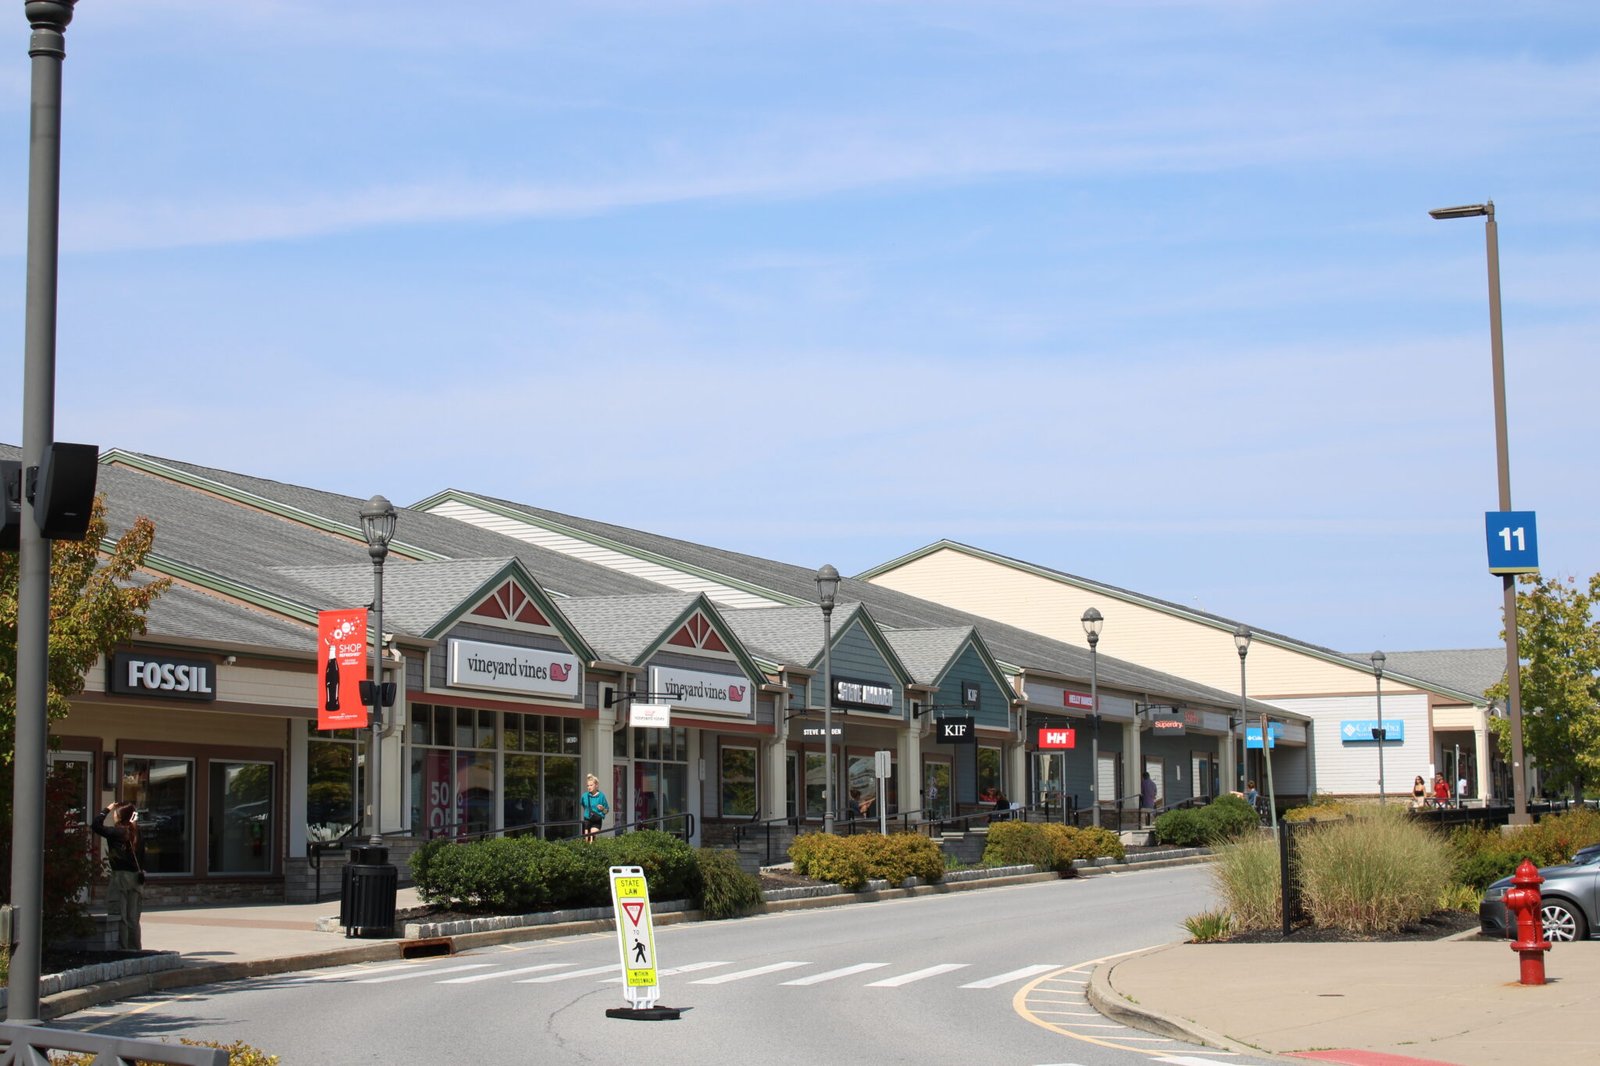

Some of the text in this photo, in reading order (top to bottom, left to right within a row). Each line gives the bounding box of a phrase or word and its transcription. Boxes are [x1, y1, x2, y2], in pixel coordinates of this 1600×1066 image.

[1498, 527, 1525, 551] 11
[339, 643, 362, 653] SHOP
[467, 653, 547, 680] vineyard vines
[128, 660, 212, 693] FOSSIL
[665, 678, 727, 701] vineyard vines
[803, 728, 819, 736] STEVE
[944, 724, 967, 736] KIF
[620, 879, 640, 887] STATE
